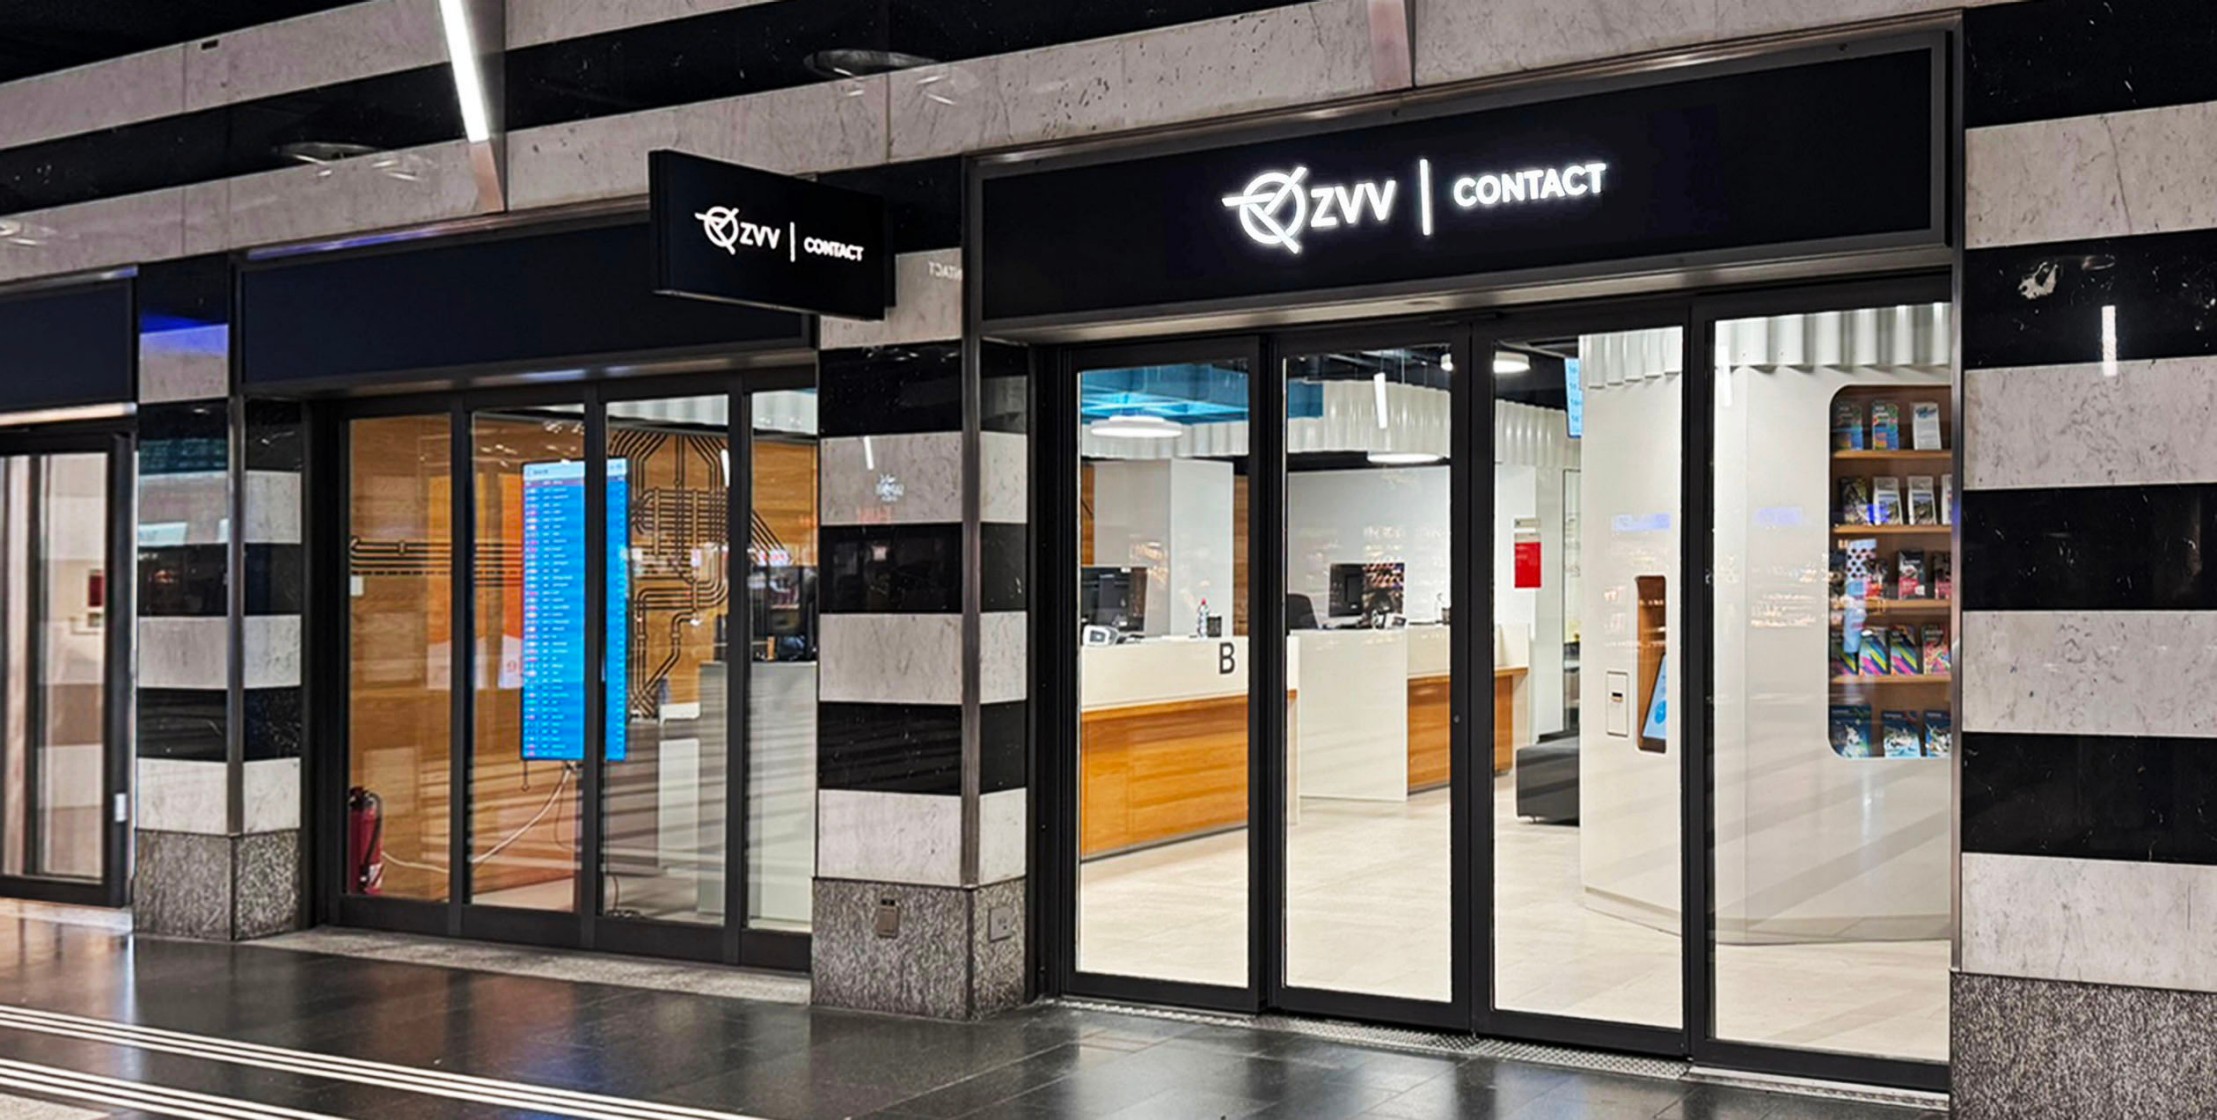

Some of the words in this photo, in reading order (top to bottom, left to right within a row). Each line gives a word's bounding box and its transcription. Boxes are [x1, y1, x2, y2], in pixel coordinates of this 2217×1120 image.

[1310, 180, 1397, 229] ZVV
[1453, 161, 1607, 208] CONTACT
[739, 221, 781, 249] ZVV
[803, 236, 864, 262] CONTACT
[1219, 642, 1235, 675] B
